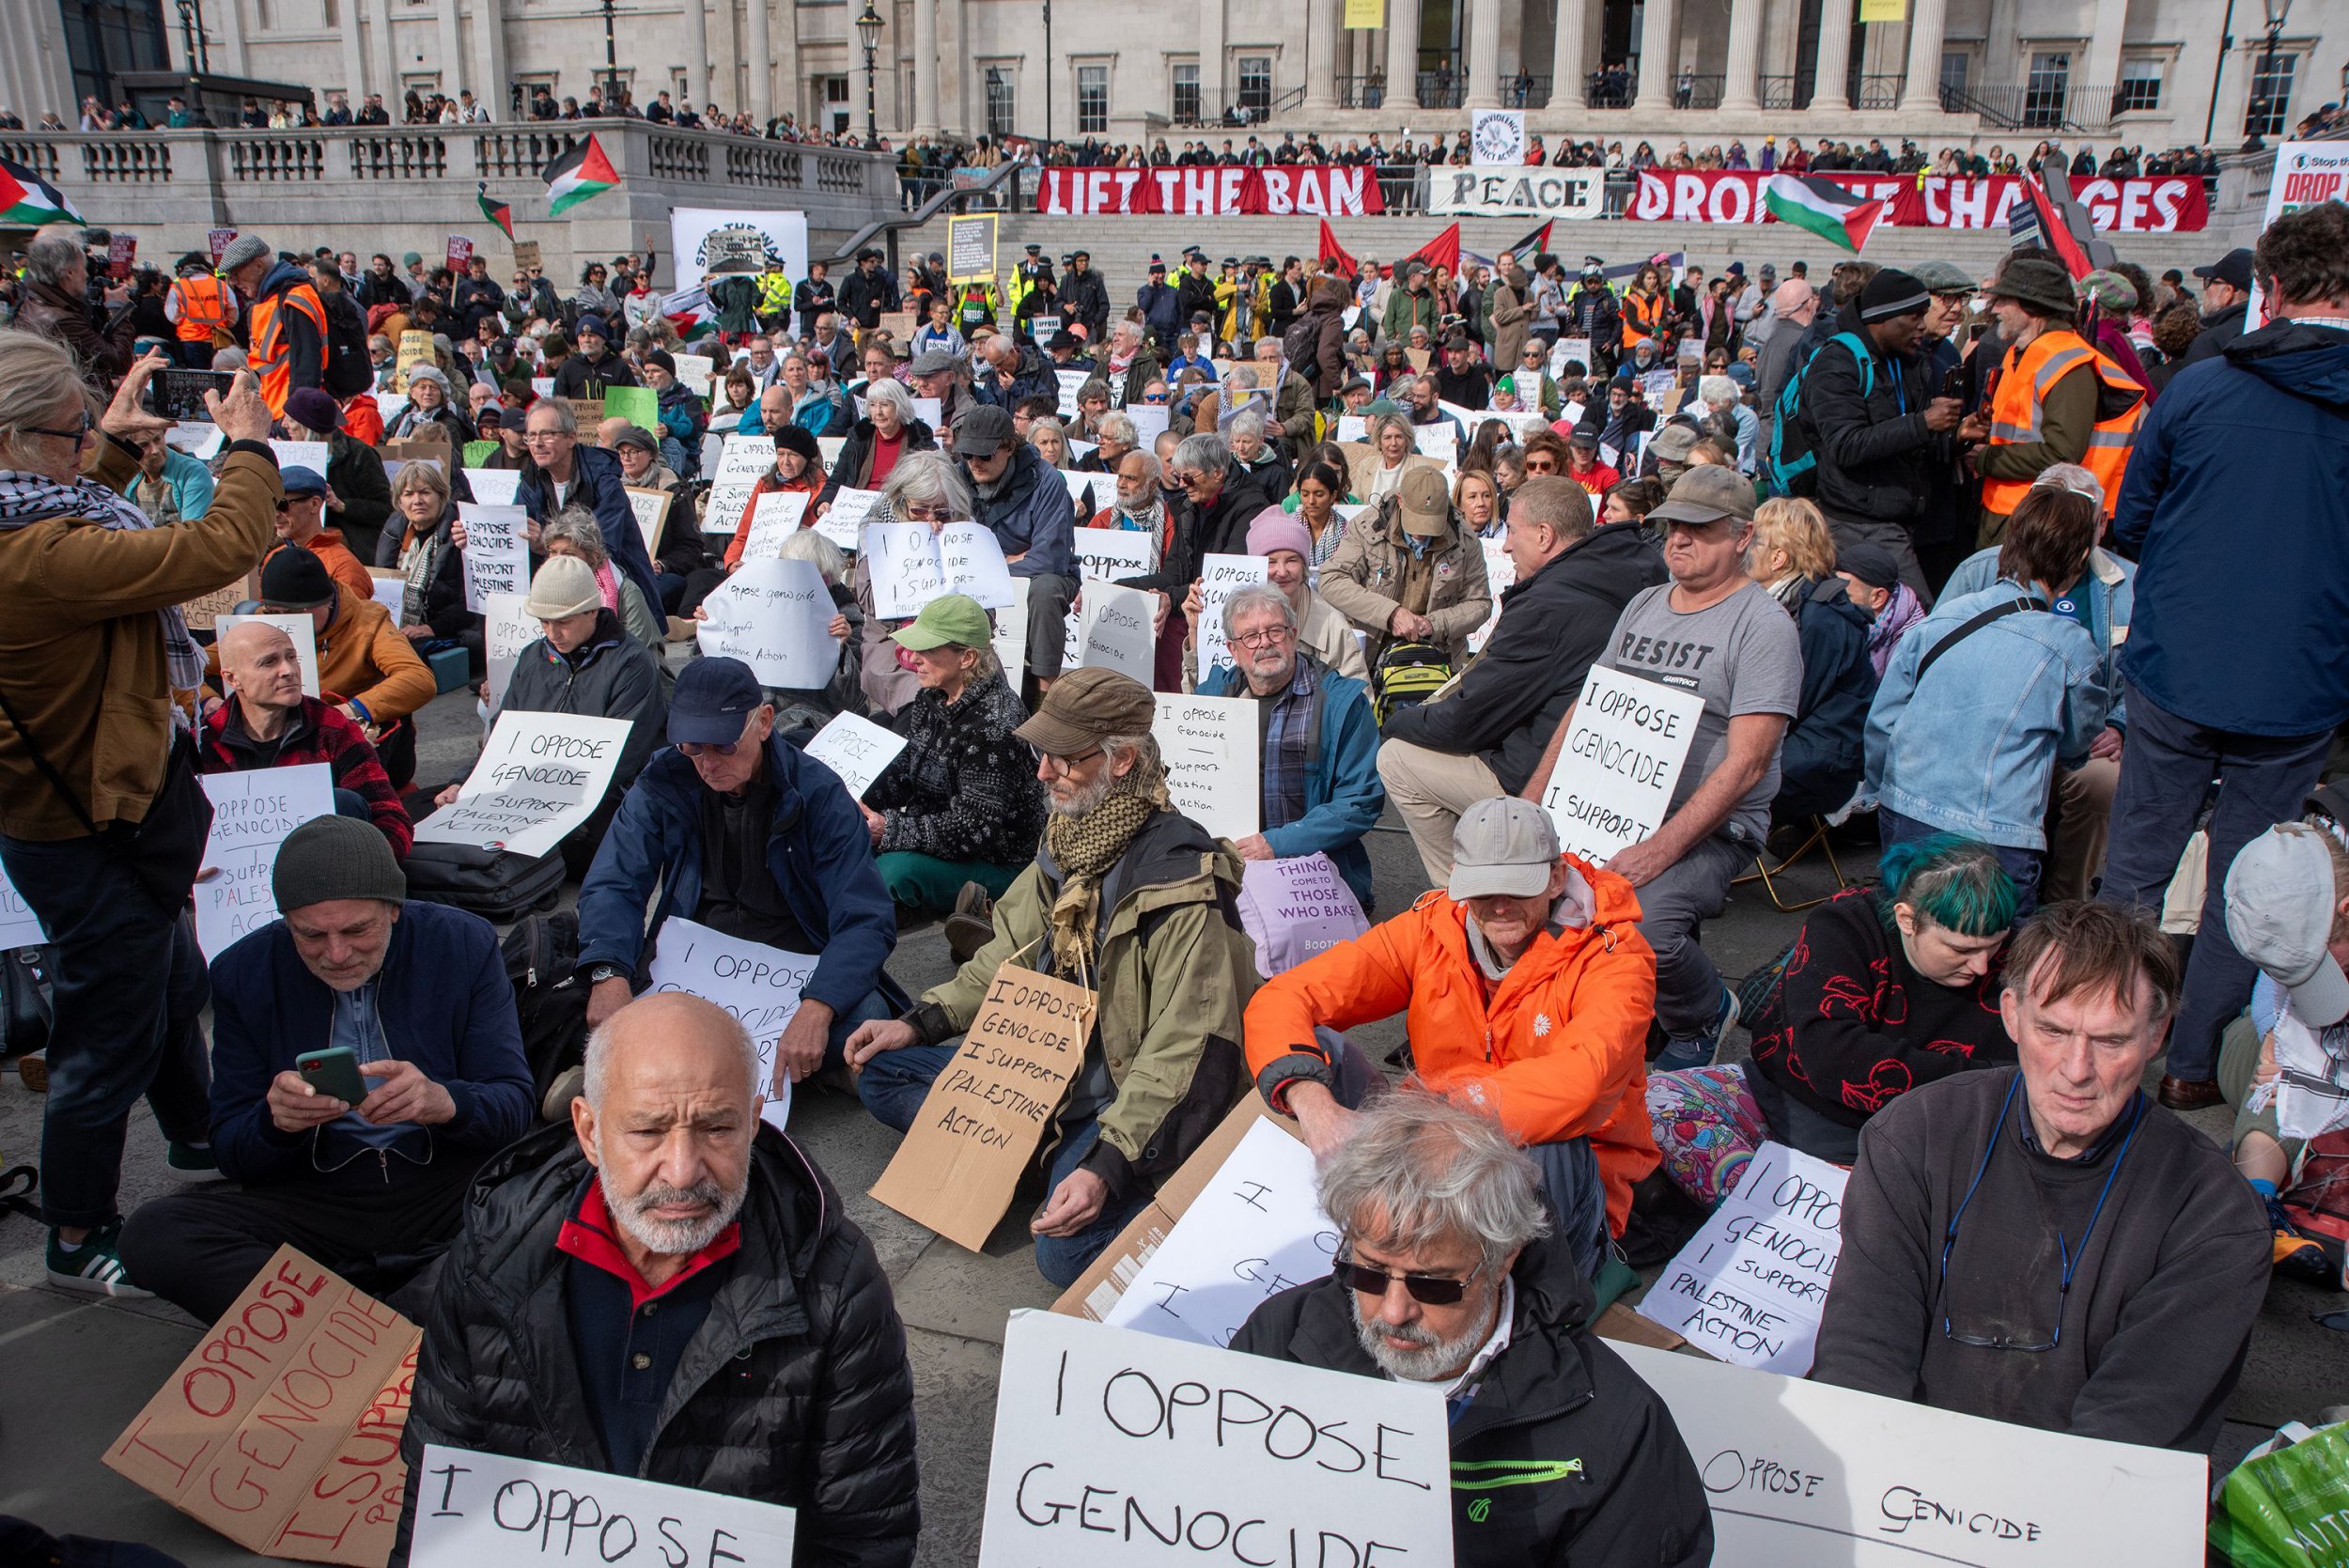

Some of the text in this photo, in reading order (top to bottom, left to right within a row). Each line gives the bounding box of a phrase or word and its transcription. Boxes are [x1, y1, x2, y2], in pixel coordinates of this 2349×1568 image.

[1476, 113, 1519, 135] NONVIOLENCE
[1475, 140, 1519, 162] DIRECT ACTION
[2311, 157, 2338, 168] Stop
[1047, 169, 1141, 215] LIFT
[1156, 168, 1244, 215] THE
[1262, 168, 1364, 217] BAN
[1452, 173, 1589, 209] PEACE
[2283, 173, 2341, 202] DROP
[1925, 178, 2189, 232] CHAGES
[928, 341, 951, 350] DOCTOR
[726, 442, 775, 456] I OPPOS
[726, 458, 769, 474] GENOCID
[712, 488, 721, 499] I
[714, 502, 746, 513] PALES
[757, 505, 793, 520] OPPOSE
[464, 521, 510, 535] I OPPOSE
[714, 515, 740, 527] ACT
[750, 516, 795, 532] GENOCIDE
[468, 536, 514, 550] GENOCIDE
[883, 534, 889, 558] I
[469, 558, 516, 575] I SUPPORT
[902, 555, 969, 579] GENOCIDE
[1207, 567, 1258, 583] I OPPOSE
[472, 575, 514, 592] PALESTINE
[893, 575, 975, 601] I SUPPORT
[185, 598, 235, 614] PALESTIN
[730, 582, 760, 602] oppose
[766, 589, 817, 611] genocide
[186, 612, 215, 627] ACTI
[1087, 600, 1140, 630] I OPPOSE
[726, 620, 755, 640] support
[755, 647, 787, 662] Action
[1087, 636, 1126, 660] GENOCIDE
[1618, 631, 1714, 672] RESIST
[1162, 706, 1226, 722] I OPPOSE
[1585, 681, 1680, 739] I OPPOSE
[508, 731, 612, 759] I OPPOSE
[828, 728, 879, 760] OPPOSE
[1174, 762, 1221, 774] support
[1572, 727, 1669, 790] GENOCIDE
[247, 774, 252, 796] I
[491, 763, 591, 786] GENOCIDE
[218, 795, 288, 820] OPPOSE
[470, 793, 578, 814] I SUPPORT
[1547, 786, 1650, 845] I SUPPORT
[433, 819, 528, 835] ACTION
[451, 808, 557, 826] PALESTINE
[1275, 859, 1331, 877] THING
[1291, 877, 1331, 887] COME TO
[214, 884, 272, 909] PALES
[1289, 889, 1340, 903] THOSE
[231, 909, 280, 937] ACT
[1278, 905, 1356, 919] WHO BAKE
[684, 942, 694, 963] I
[1305, 939, 1340, 950] BOOTH
[988, 979, 1015, 1003] I
[982, 1013, 1070, 1052] GENOCIDE
[963, 1041, 1066, 1083] I SUPPORT
[941, 1069, 1050, 1123] PALESTINE
[938, 1107, 1014, 1149] ACTION
[1745, 1162, 1842, 1233] I OPPO
[1699, 1244, 1828, 1304] I SUPPORT
[1670, 1273, 1790, 1331] PALESTINE
[1682, 1309, 1783, 1358] ACTION
[119, 1259, 329, 1489] I OPPOSE
[210, 1288, 399, 1513] GENOCIDE
[1056, 1350, 1431, 1491] I OPPOSE
[1702, 1449, 2043, 1544] OPPOSE GENICIDE
[430, 1464, 473, 1516] I
[493, 1479, 745, 1568] OPPOSE
[274, 1511, 358, 1551] I
